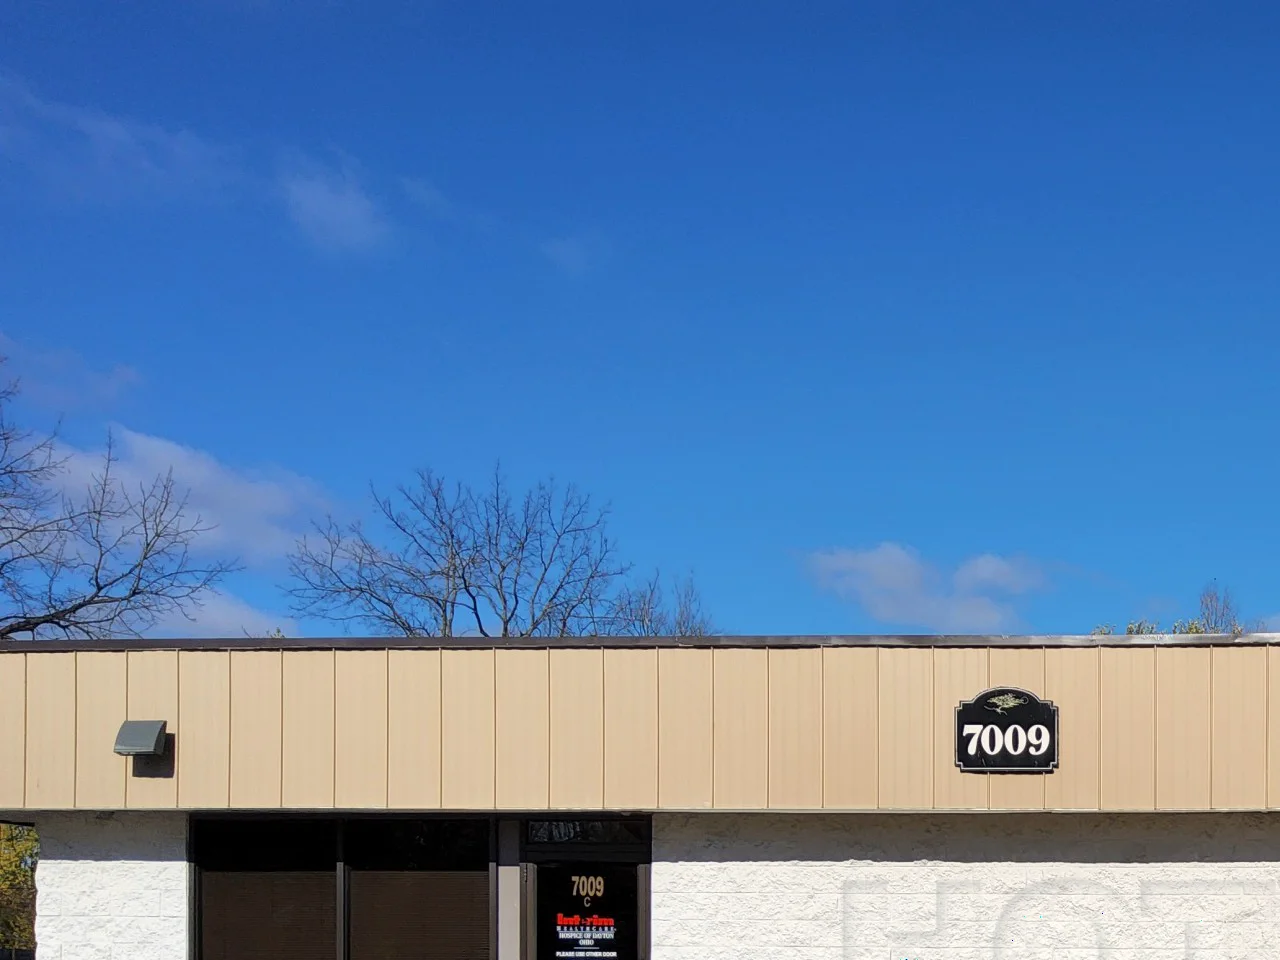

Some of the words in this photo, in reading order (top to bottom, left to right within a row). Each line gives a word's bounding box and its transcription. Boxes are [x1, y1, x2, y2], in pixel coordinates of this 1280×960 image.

[962, 724, 1050, 755] 7009
[571, 875, 604, 896] 7009
[583, 896, 591, 908] C
